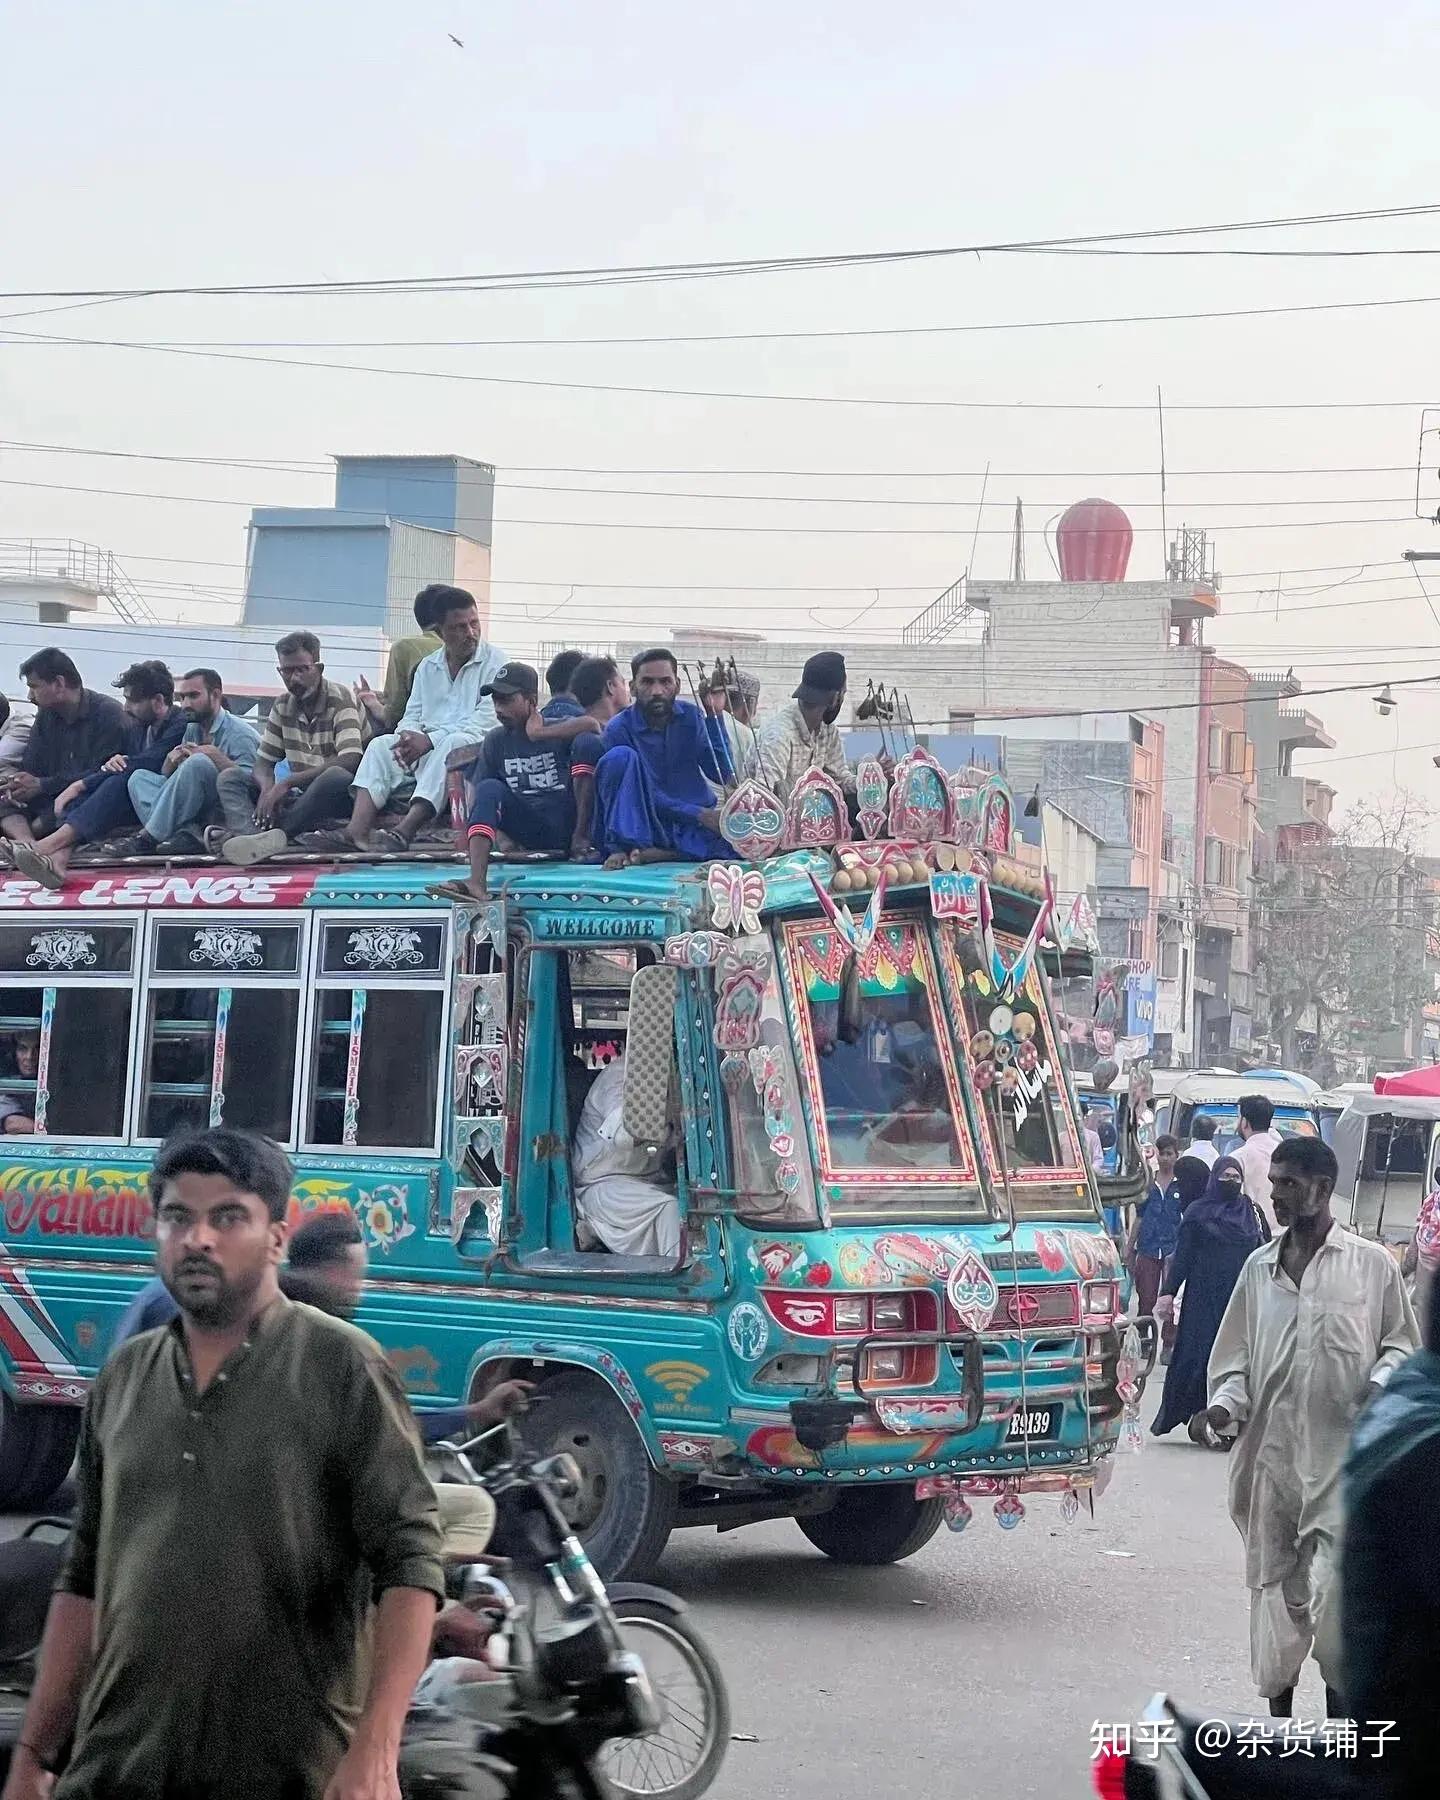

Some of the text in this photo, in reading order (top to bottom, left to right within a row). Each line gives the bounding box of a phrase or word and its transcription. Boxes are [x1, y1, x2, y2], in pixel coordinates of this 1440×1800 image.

[504, 752, 557, 775] FREE
[506, 769, 560, 793] FRE
[546, 917, 655, 937] WELLCOME
[1127, 961, 1152, 974] SHOP
[347, 1035, 360, 1097] ISMAIL
